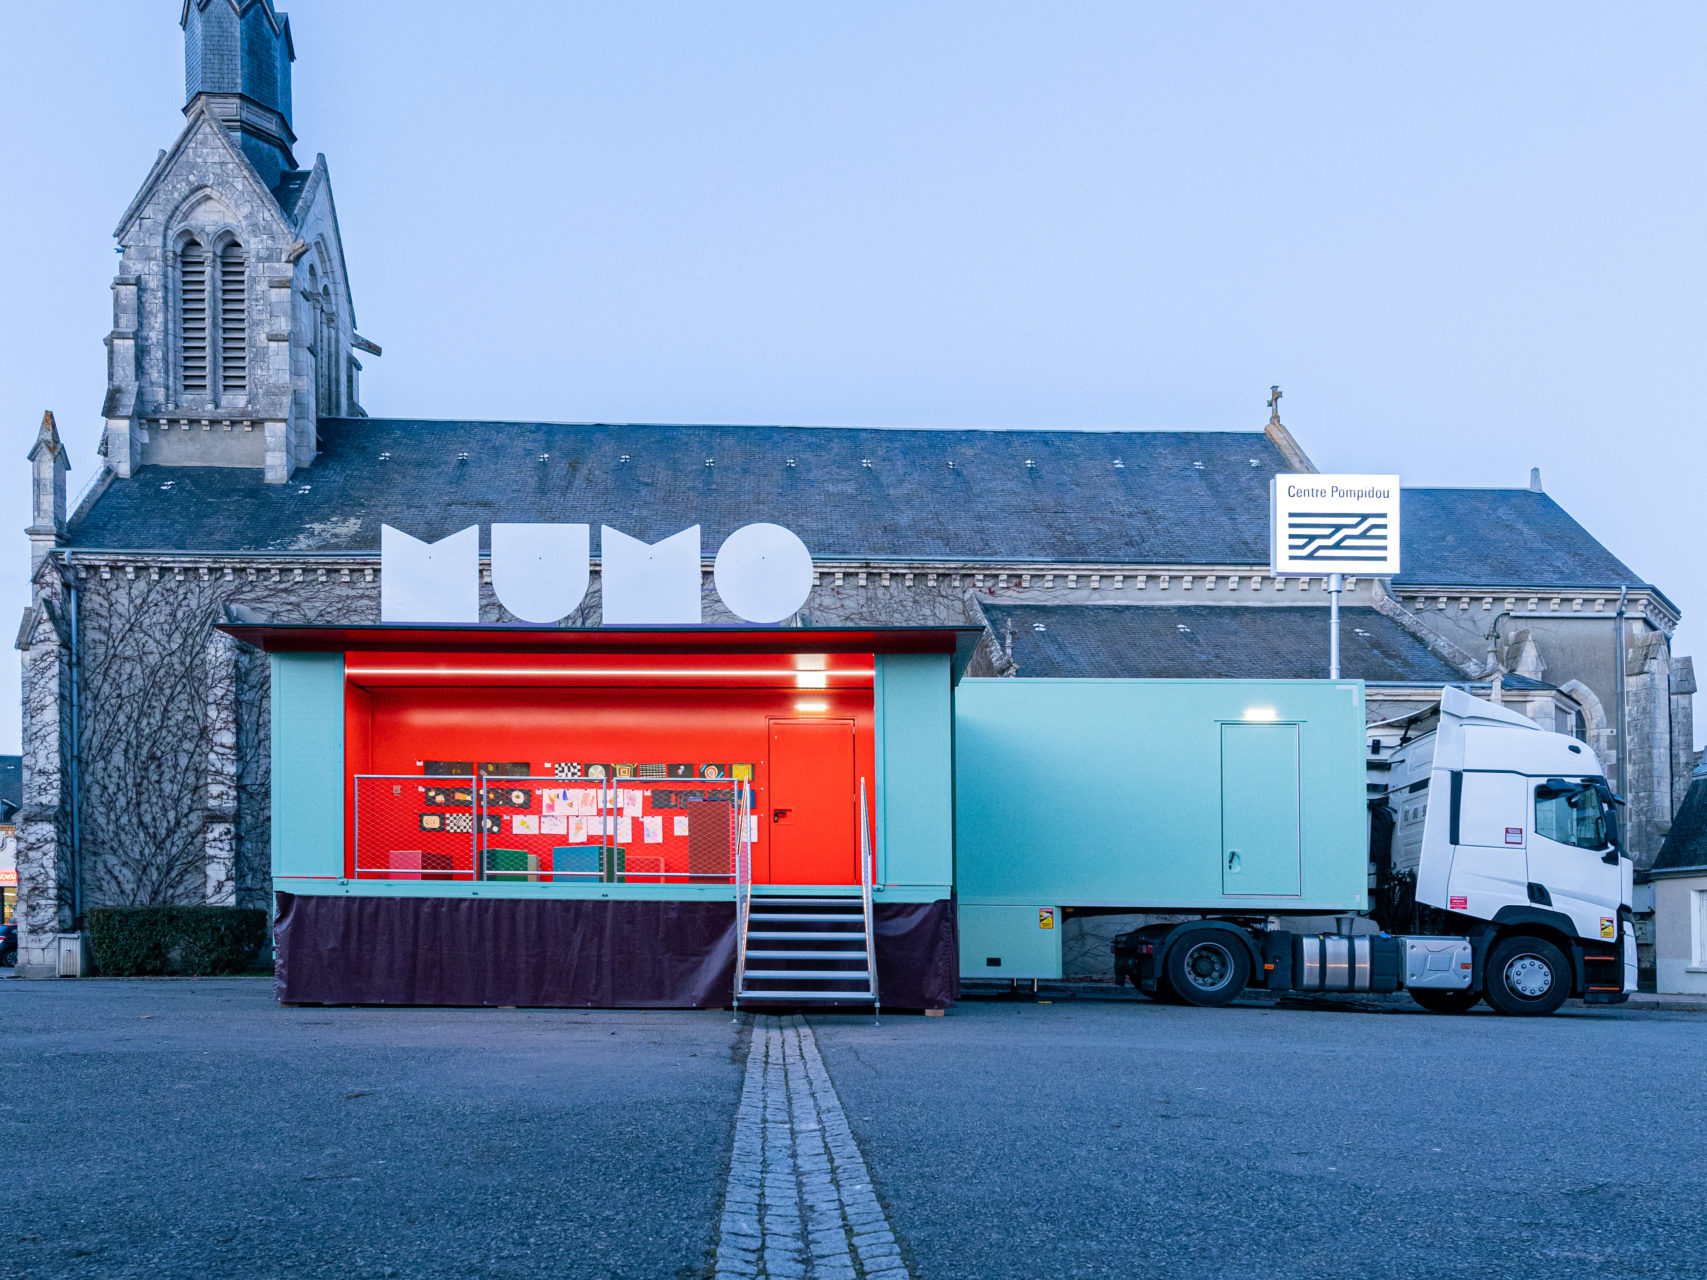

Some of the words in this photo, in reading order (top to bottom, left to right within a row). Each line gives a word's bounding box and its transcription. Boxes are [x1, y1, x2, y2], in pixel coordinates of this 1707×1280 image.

[1288, 485, 1327, 498] Centre
[1331, 486, 1390, 501] Pompidou
[381, 522, 814, 624] MUMO
